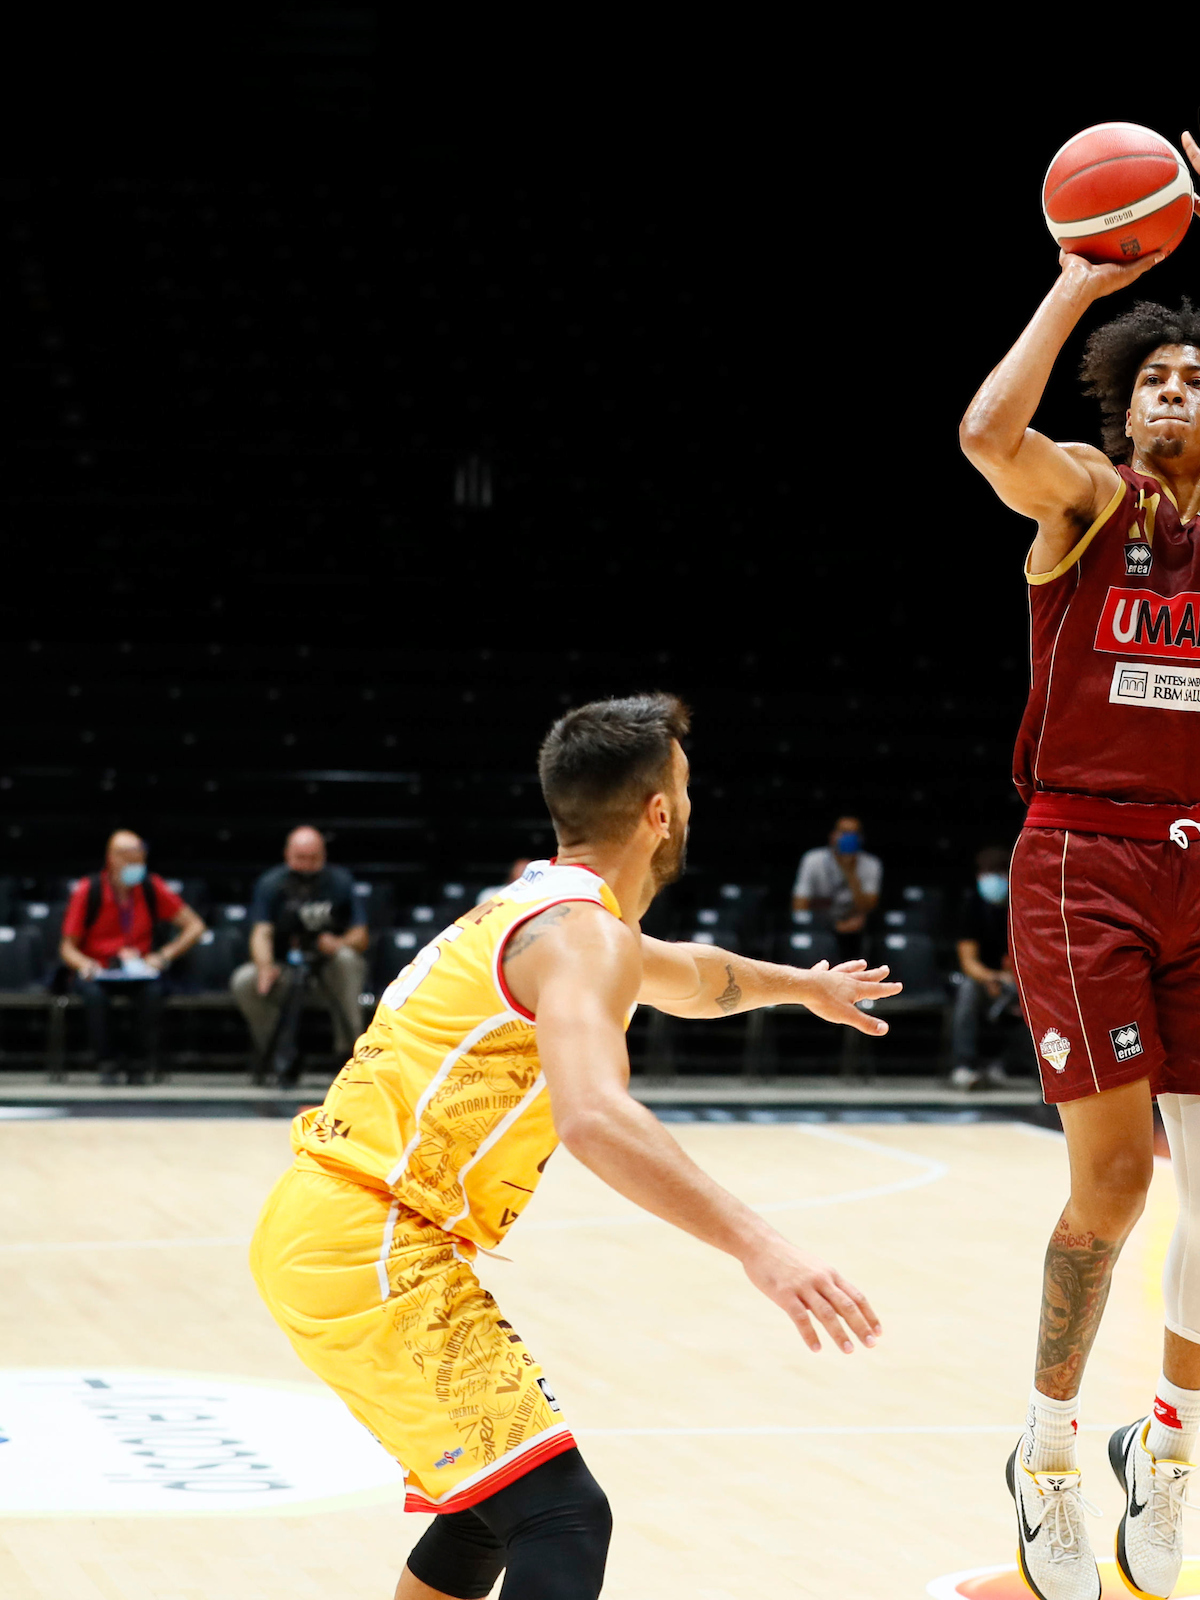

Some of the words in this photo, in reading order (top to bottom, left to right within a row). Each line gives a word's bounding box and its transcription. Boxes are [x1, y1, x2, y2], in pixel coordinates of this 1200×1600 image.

[1154, 674, 1186, 687] INTESA
[1153, 686, 1183, 701] RBM
[443, 1096, 490, 1120] VICTORIA
[492, 1094, 526, 1109] LIBER
[435, 1359, 453, 1404] VICTORIA
[444, 1315, 475, 1359] LIBERTAS
[515, 1380, 540, 1423] LIBERTA
[448, 1404, 480, 1421] LIBERTAS
